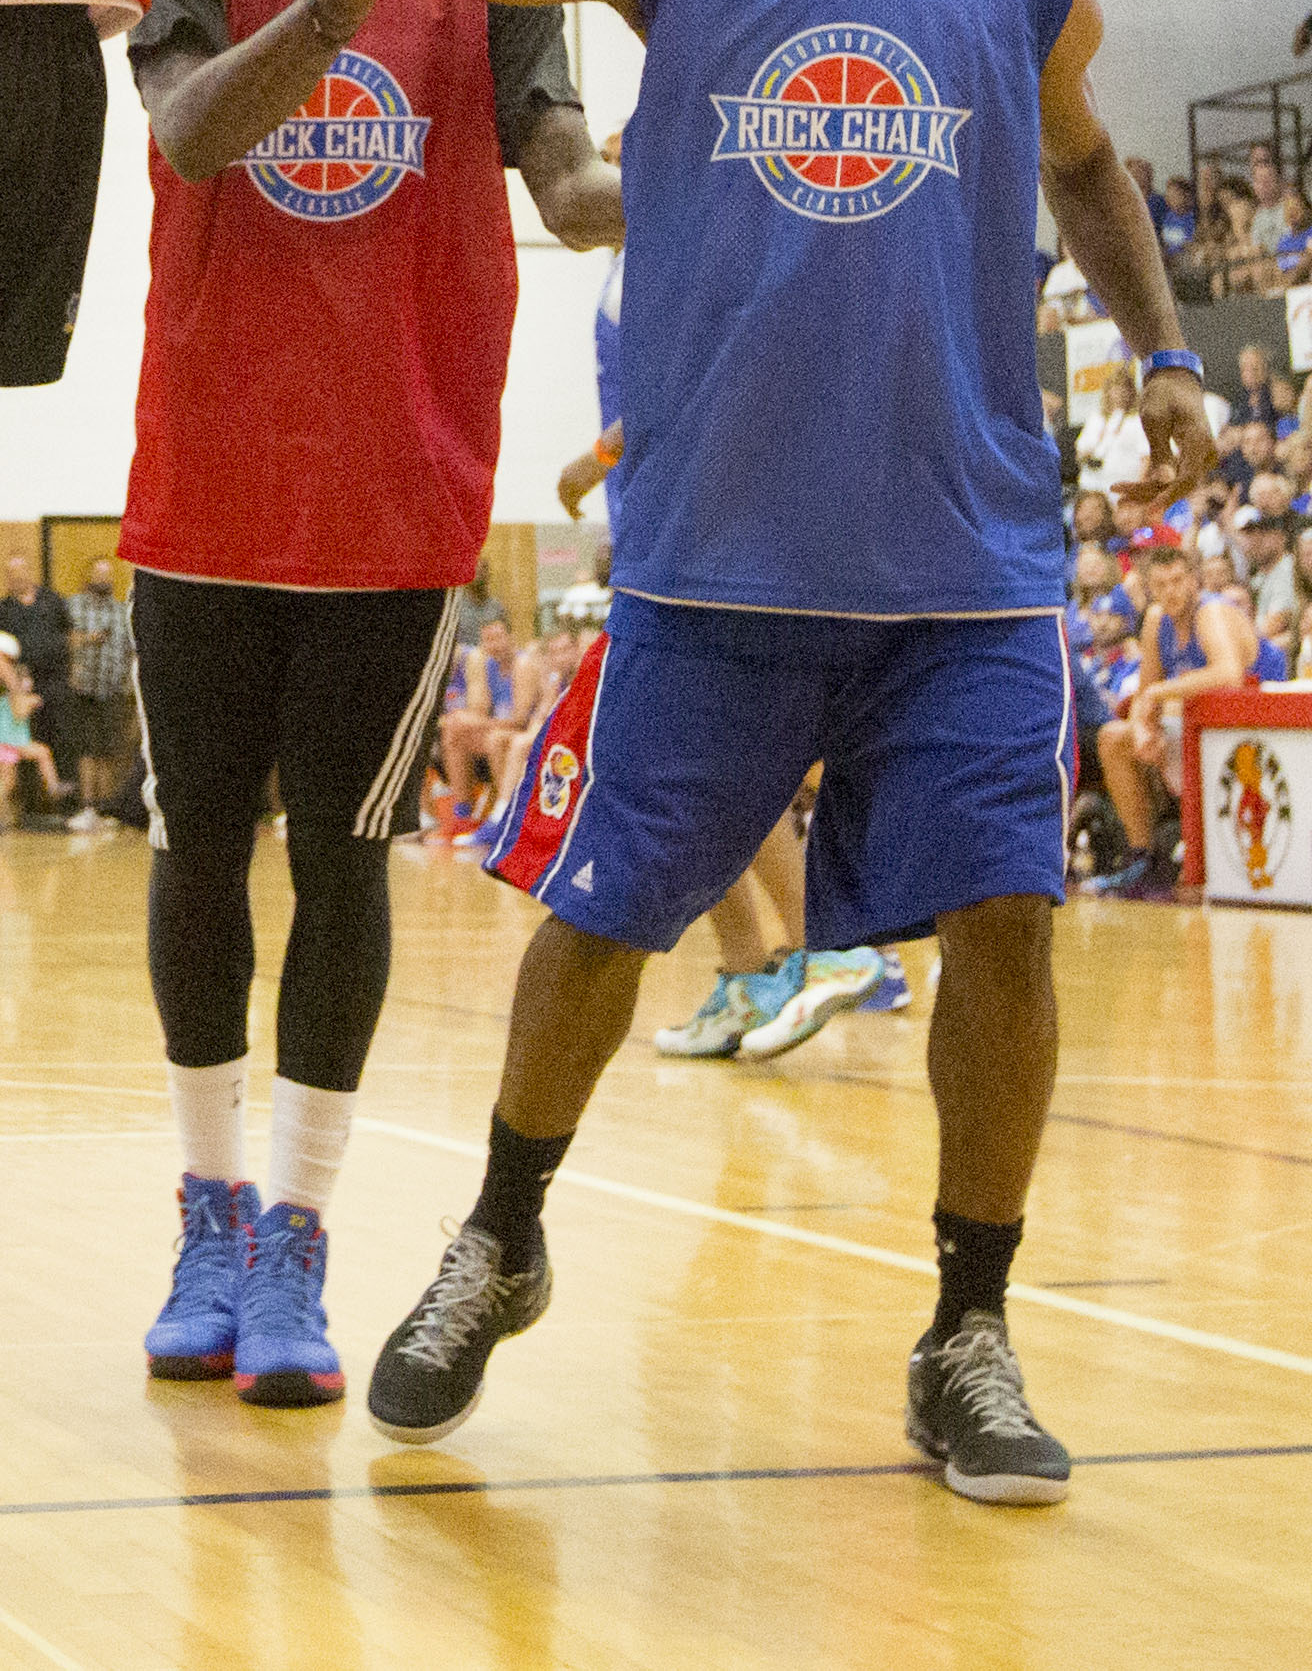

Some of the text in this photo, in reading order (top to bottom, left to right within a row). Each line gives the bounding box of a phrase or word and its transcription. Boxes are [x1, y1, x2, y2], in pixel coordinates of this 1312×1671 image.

[248, 123, 421, 162] OCK CHALK
[738, 105, 949, 161] ROCK CHALK
